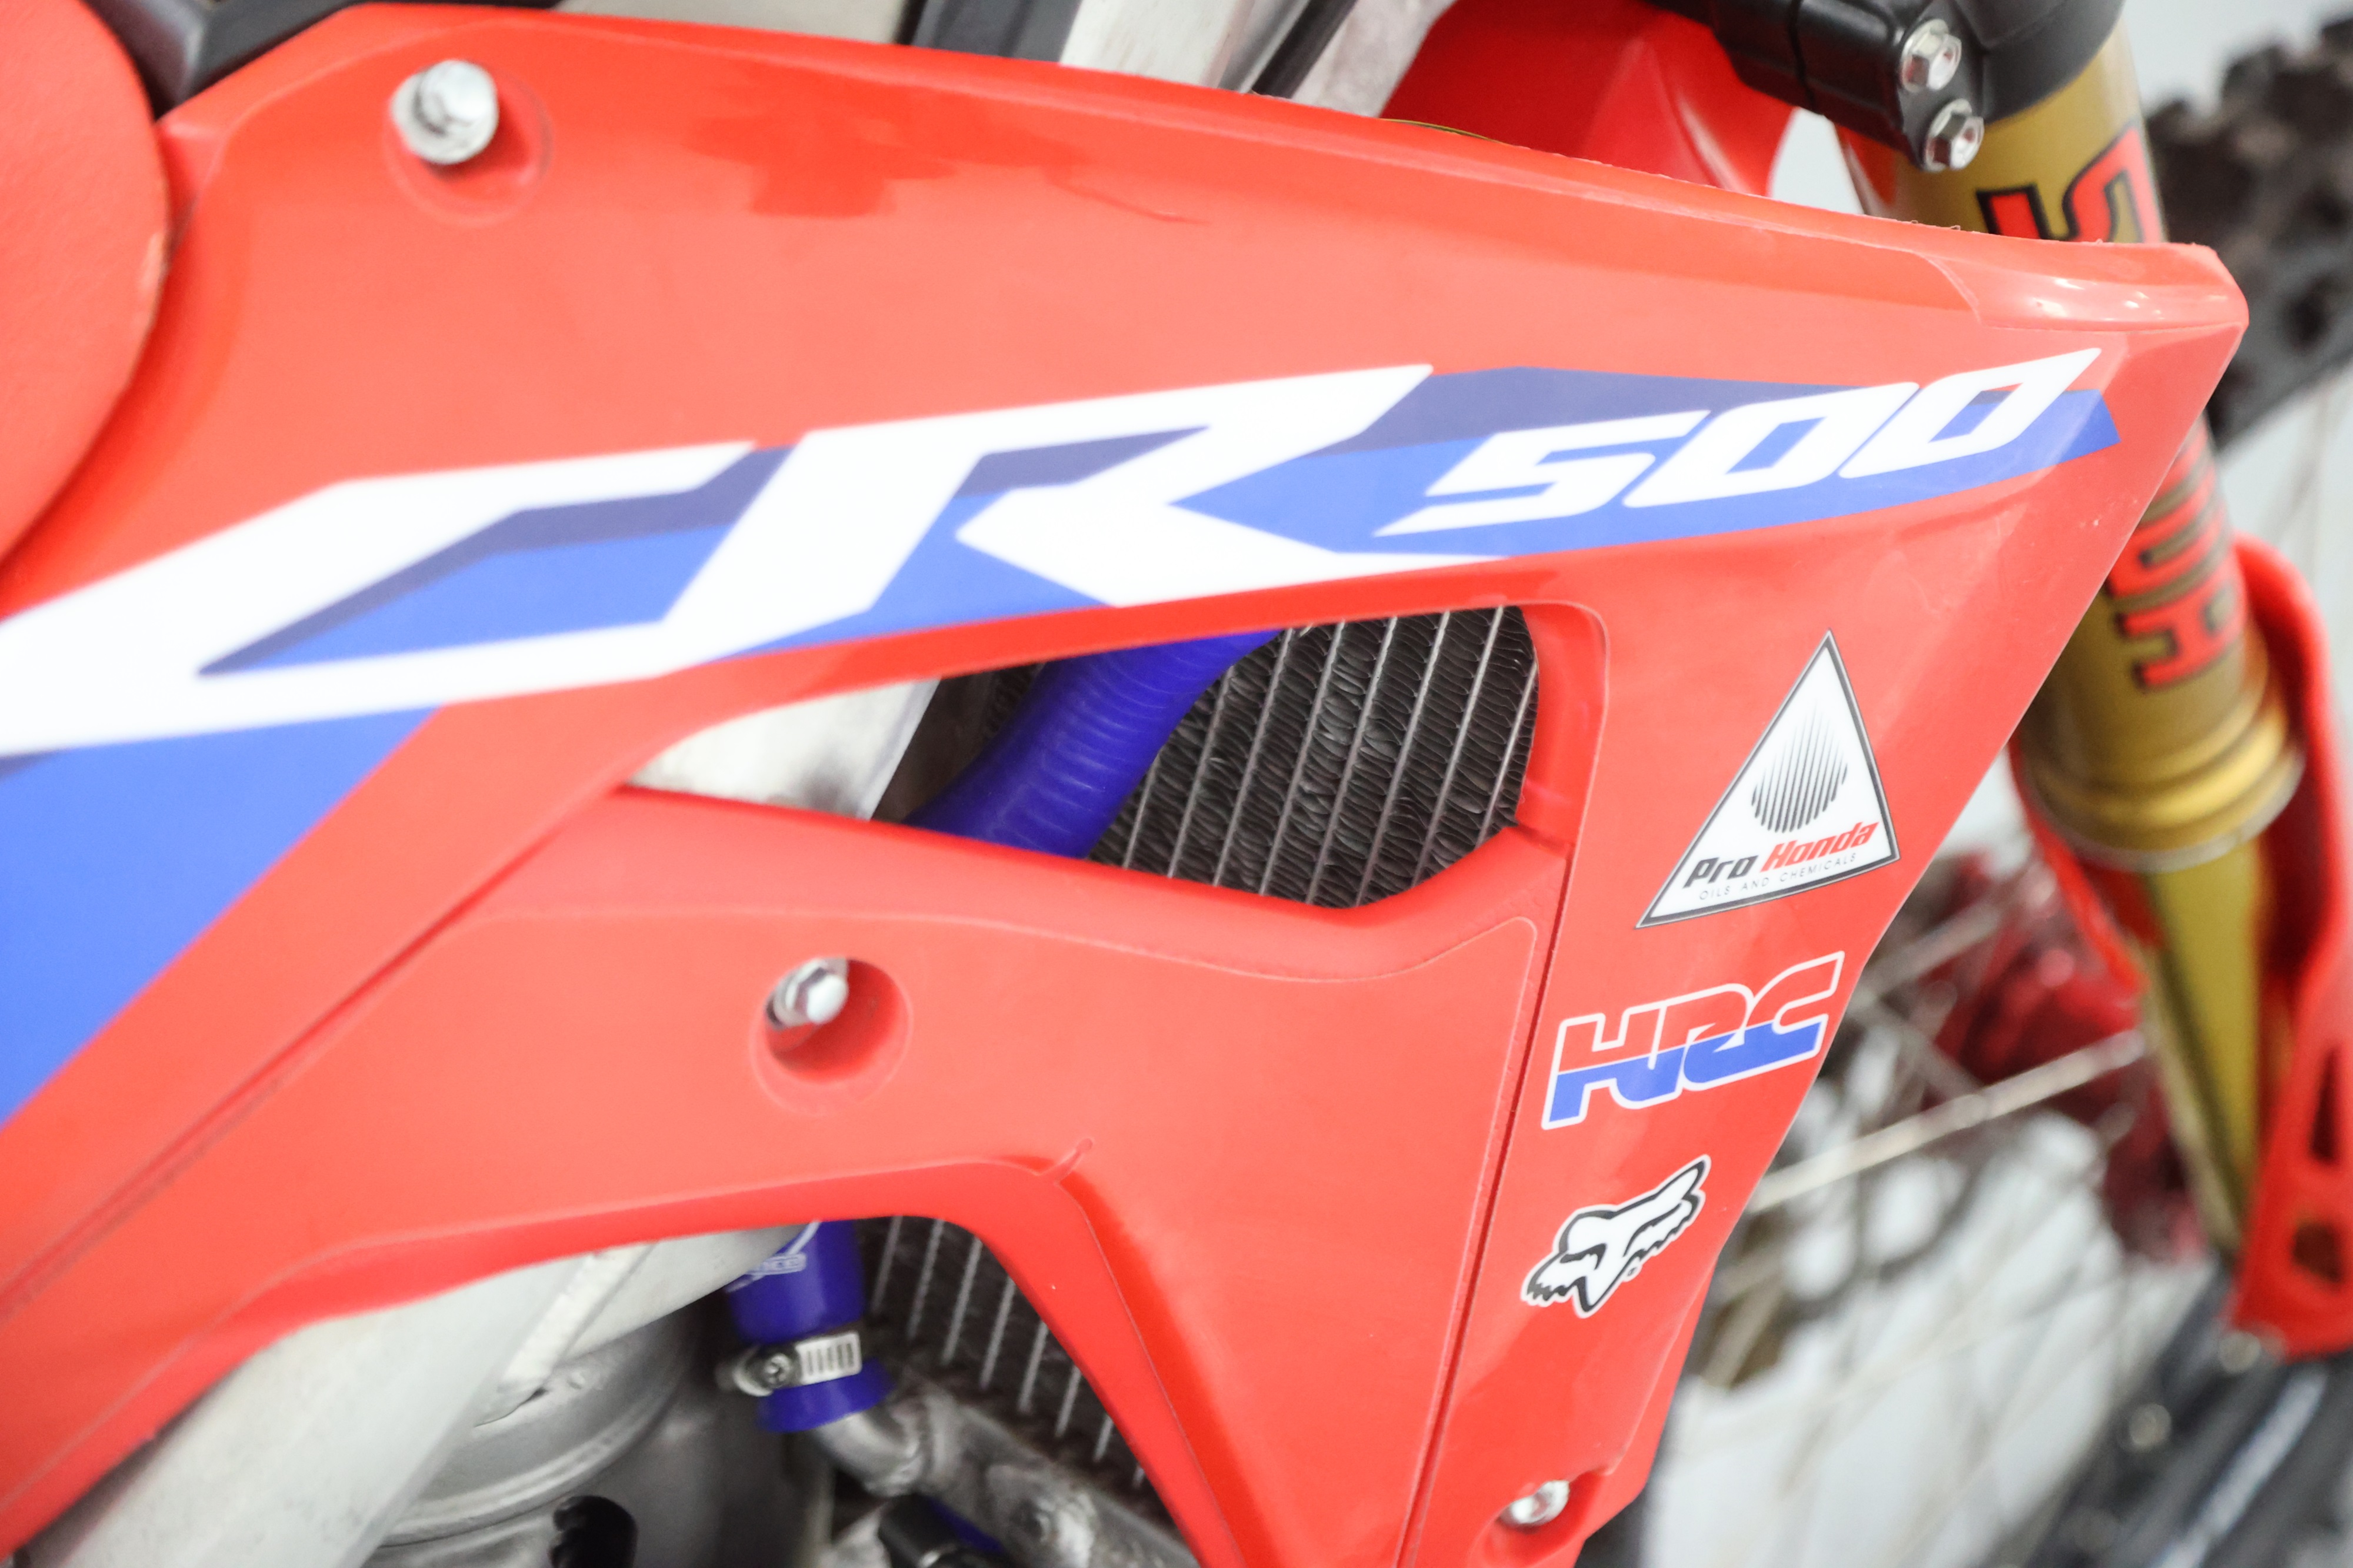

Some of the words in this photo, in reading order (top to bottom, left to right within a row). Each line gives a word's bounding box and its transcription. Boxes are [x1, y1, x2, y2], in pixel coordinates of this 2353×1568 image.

[0, 365, 1507, 758] CR
[1372, 348, 2102, 537] 500
[1682, 855, 1758, 889] Pro
[1760, 821, 1879, 873] Honda
[1699, 885, 1731, 900] OILS
[1741, 876, 1769, 890] AND
[1780, 852, 1857, 882] CHEMICALS
[1541, 951, 1845, 1130] HRC
